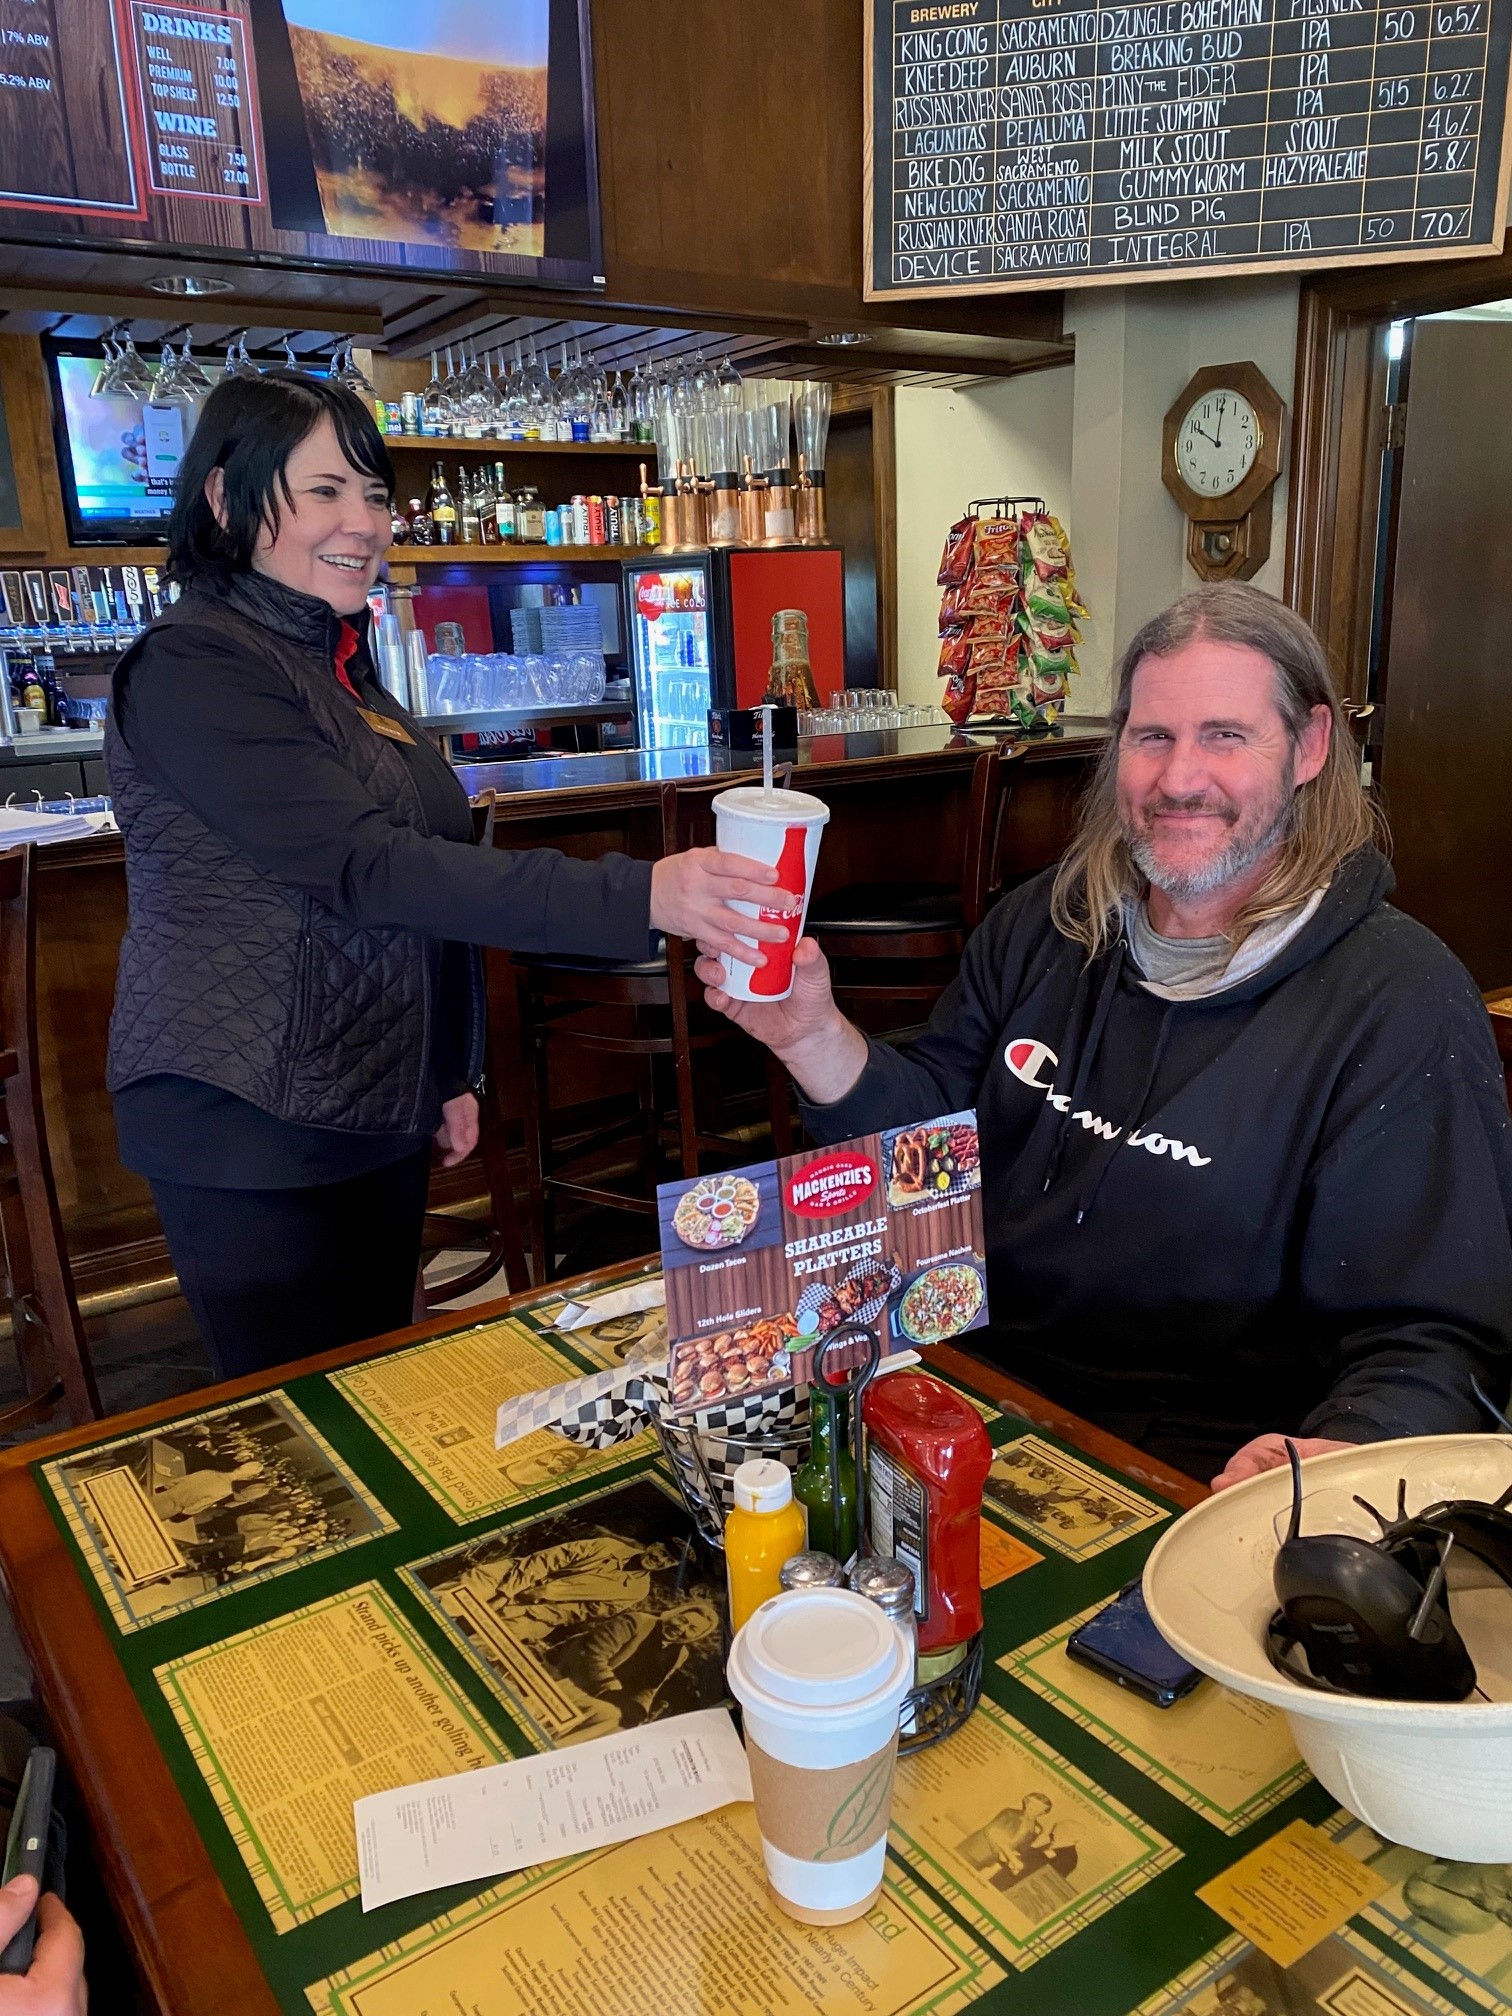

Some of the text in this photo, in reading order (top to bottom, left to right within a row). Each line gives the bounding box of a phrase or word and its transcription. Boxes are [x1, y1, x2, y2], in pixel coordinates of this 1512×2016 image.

[910, 2, 978, 23] BREWERY
[1101, 0, 1262, 40] DZUNGLE BOHEMIAN
[1385, 11, 1415, 41] 50
[1437, 4, 1481, 34] 6.5%
[7, 30, 49, 48] 7% ABV
[142, 12, 232, 44] DRINKS
[1000, 13, 1096, 51] SACRAMENTO
[1302, 18, 1330, 50] IPA
[147, 45, 236, 71] WELL 7.00
[901, 27, 988, 62] KING CONG
[1111, 30, 1243, 71] BREAKING BUD
[149, 64, 238, 90] PREMIUM 10.00
[905, 58, 989, 94] KNEE DEEP
[1005, 50, 1076, 82] AUBURN
[1300, 53, 1329, 86] IPA
[0, 73, 51, 91] 5.2% ABV
[151, 82, 240, 108] TOP SHELF 12.50
[1101, 75, 1144, 109] PLINY
[1144, 80, 1167, 92] THE
[1434, 72, 1473, 100] 6.2%
[896, 89, 996, 129] RUSSIAN RIVER
[1000, 82, 1094, 121] SANTA ROSA
[1297, 88, 1323, 116] IPA
[154, 110, 217, 137] WINE
[1006, 113, 1086, 147] PETALUMA
[1105, 107, 1151, 138] LITTLE
[1285, 117, 1341, 154] STOUT
[1428, 105, 1473, 139] 4.6%
[159, 143, 247, 167] GLASS 7.50
[904, 124, 987, 156] LAGUNITAS
[1018, 146, 1054, 164] WEST
[1120, 129, 1231, 169] MILK STOUT
[996, 159, 1079, 181] SACRAMENTO
[1424, 140, 1471, 171] 5.8%
[160, 161, 249, 185] BOTTLE 27.00
[908, 155, 985, 188] BIKE DOG
[940, 186, 987, 215] GLORY
[996, 176, 1090, 210] SACRAMENTO
[994, 208, 1087, 244] SANTA ROSA
[1115, 197, 1226, 230] BLIND PIG
[898, 217, 994, 250] RUSSIAN RIVER
[1284, 220, 1312, 251] IPA
[1365, 218, 1395, 241] 50
[996, 242, 1089, 271] SACRAMENTO
[1108, 229, 1227, 264] INTEGRAL
[900, 250, 980, 280] DEVICE
[1190, 419, 1201, 434] 10
[1241, 414, 1249, 430] 2
[1186, 440, 1193, 453] 9
[1245, 434, 1253, 450] 3
[1227, 469, 1235, 484] 5
[610, 506, 619, 539] TRULY
[684, 598, 706, 608] COLD
[792, 1165, 872, 1206] MACKENZIE'S
[912, 1193, 972, 1216] Octoberfest Platter
[784, 1217, 888, 1258] SHAREABLE
[699, 1257, 747, 1274] Dozen Tacos
[793, 1239, 883, 1277] PLATTERS
[916, 1244, 973, 1267] Foursome Nachos
[697, 1306, 762, 1328] 12th Hole Sliders
[848, 1336, 855, 1345] &
[366, 1396, 397, 1418] Friend
[421, 1448, 442, 1468] Been
[439, 1466, 458, 1482] Has
[446, 1480, 482, 1508] Strand
[352, 1601, 386, 1632] Strand
[375, 1633, 401, 1659] picks
[394, 1658, 412, 1676] up
[406, 1676, 442, 1714] another
[432, 1718, 473, 1757] golfing
[705, 1825, 731, 1848] Junior
[727, 1849, 746, 1865] and
[805, 1932, 833, 1964] Nearly
[840, 1973, 877, 2012] Century
[822, 1931, 879, 1991] Huge Impact
